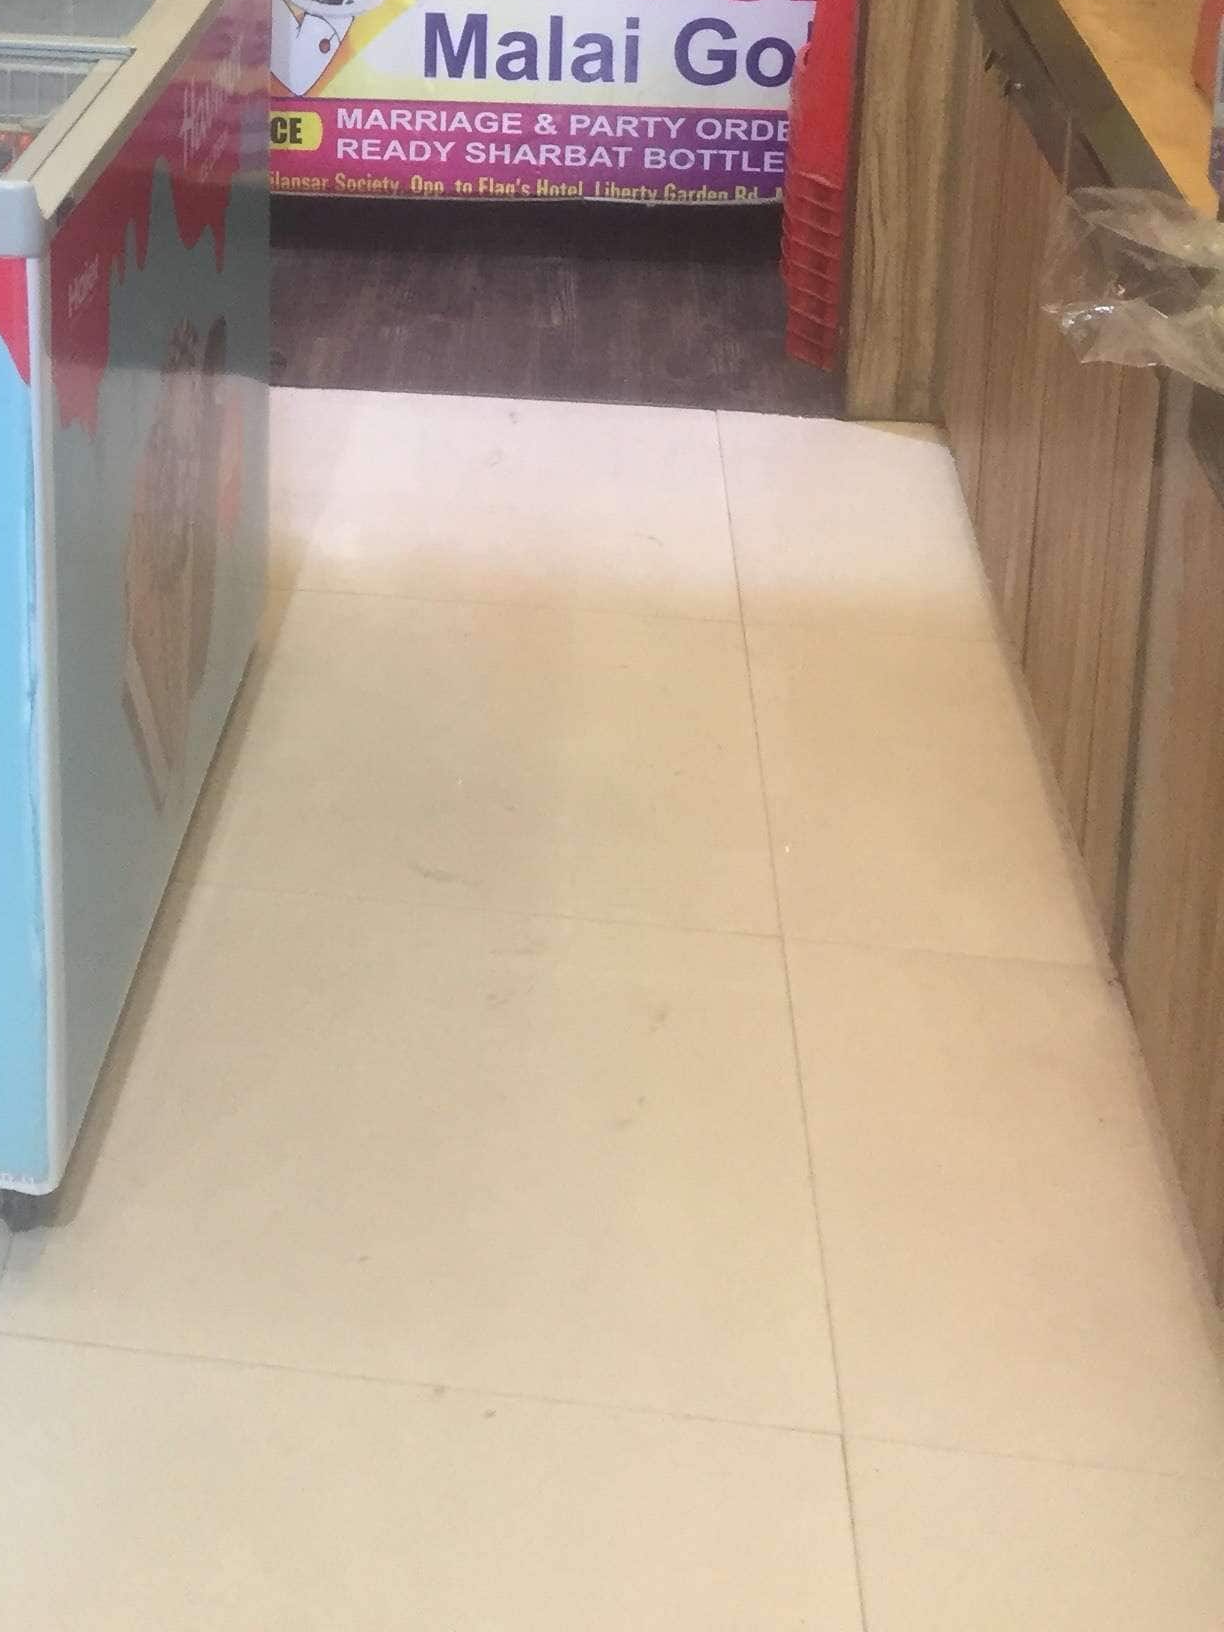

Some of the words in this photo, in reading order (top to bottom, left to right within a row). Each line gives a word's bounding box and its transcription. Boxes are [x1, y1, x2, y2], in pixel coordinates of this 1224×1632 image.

[423, 12, 641, 85] Malai
[337, 108, 523, 135] MARRIAGE
[534, 113, 557, 135] &
[570, 115, 687, 139] PARTY
[336, 139, 456, 163] READY
[465, 143, 633, 168] SHARBAT
[455, 181, 473, 194] to
[536, 179, 584, 197] Hotel
[663, 183, 729, 201] Garden
